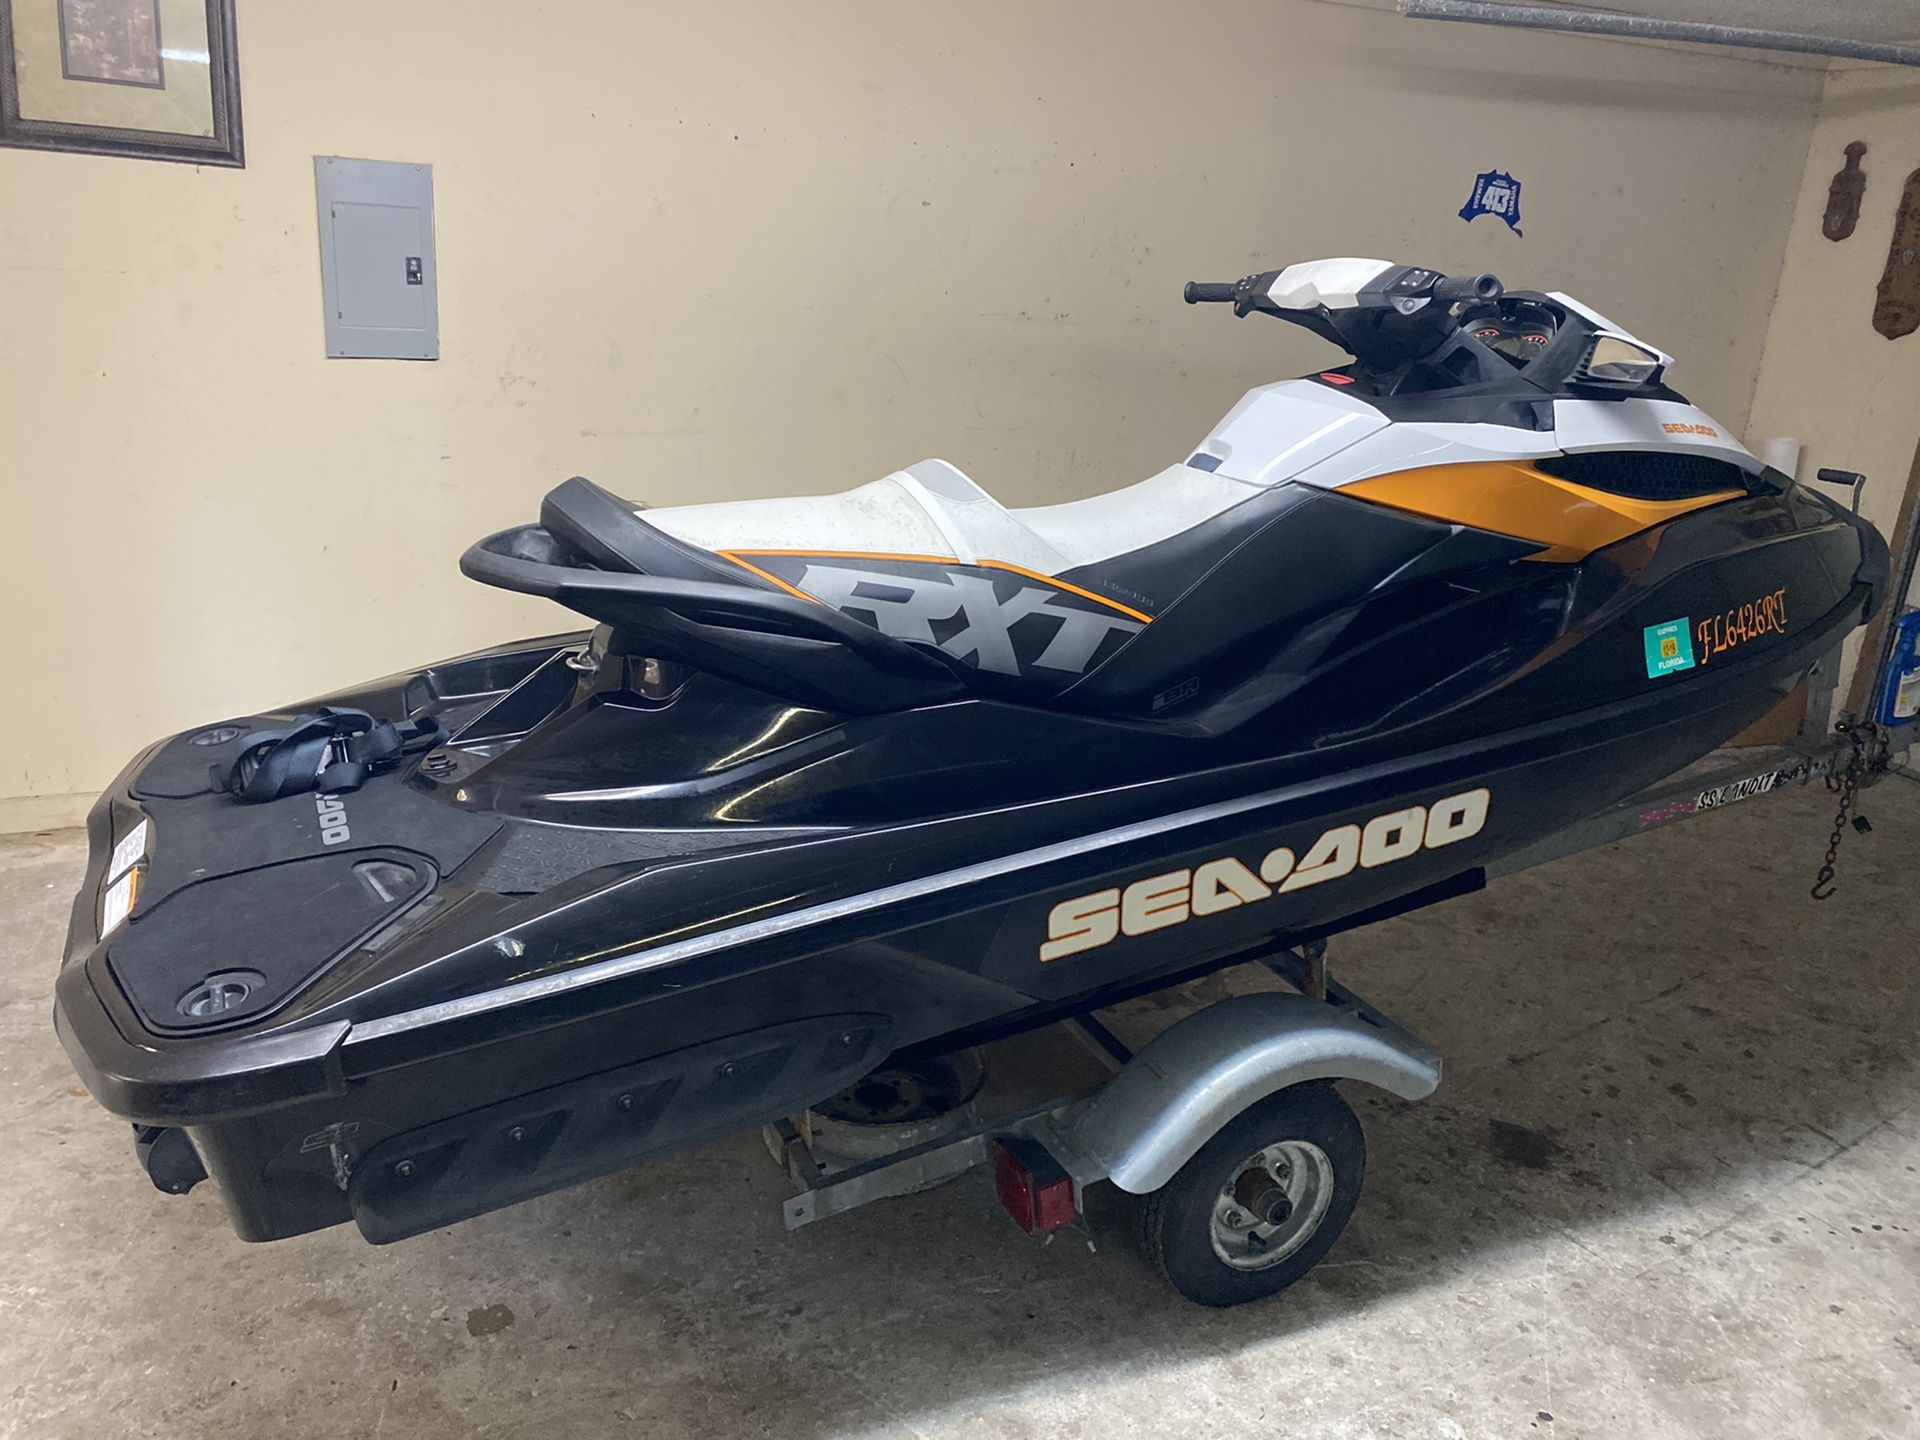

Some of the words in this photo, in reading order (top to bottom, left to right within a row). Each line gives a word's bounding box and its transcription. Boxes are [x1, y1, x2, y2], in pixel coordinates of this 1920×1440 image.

[797, 564, 1148, 677] RXT
[1697, 587, 1788, 665] FL6426RT
[1658, 656, 1685, 670] FLORIDA
